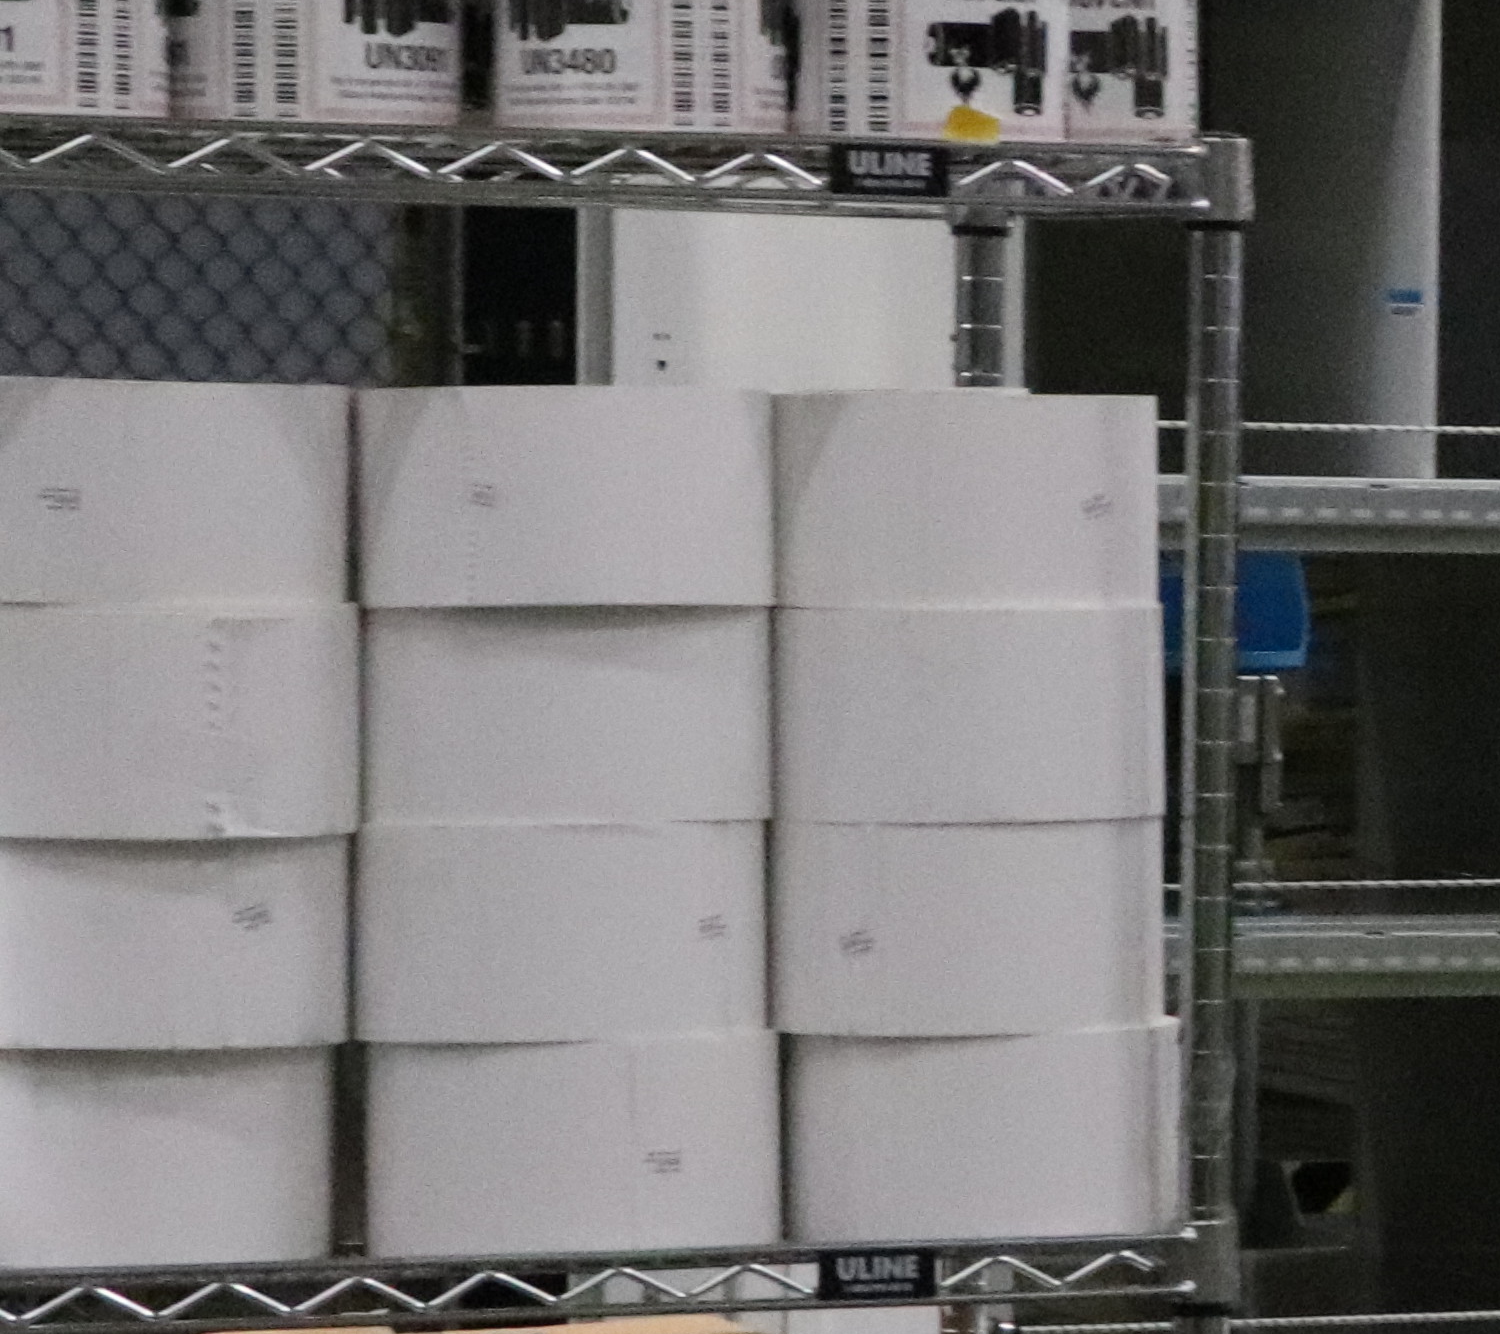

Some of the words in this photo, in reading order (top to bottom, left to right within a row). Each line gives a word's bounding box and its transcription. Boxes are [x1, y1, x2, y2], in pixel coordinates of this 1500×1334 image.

[520, 47, 617, 75] UN3480
[847, 149, 932, 177] ULINE
[835, 1254, 919, 1281] ULINE
